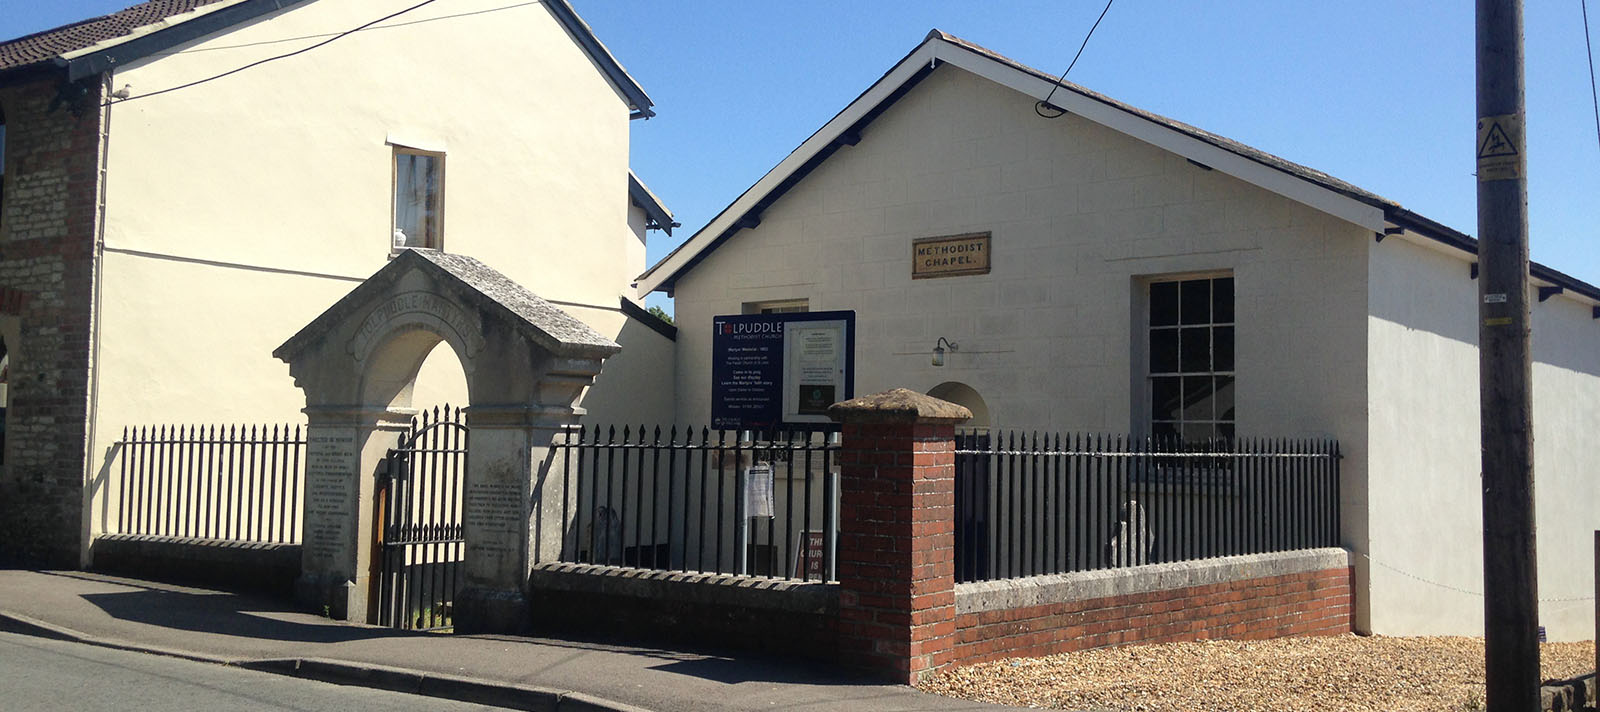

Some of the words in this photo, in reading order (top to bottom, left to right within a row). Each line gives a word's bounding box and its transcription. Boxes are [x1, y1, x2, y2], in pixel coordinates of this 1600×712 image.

[918, 243, 983, 256] METHODIST
[925, 256, 977, 267] CHAPEL.
[361, 295, 418, 338] TOLPUDDLE
[422, 295, 473, 337] MARTYRS
[811, 561, 819, 570] IS
